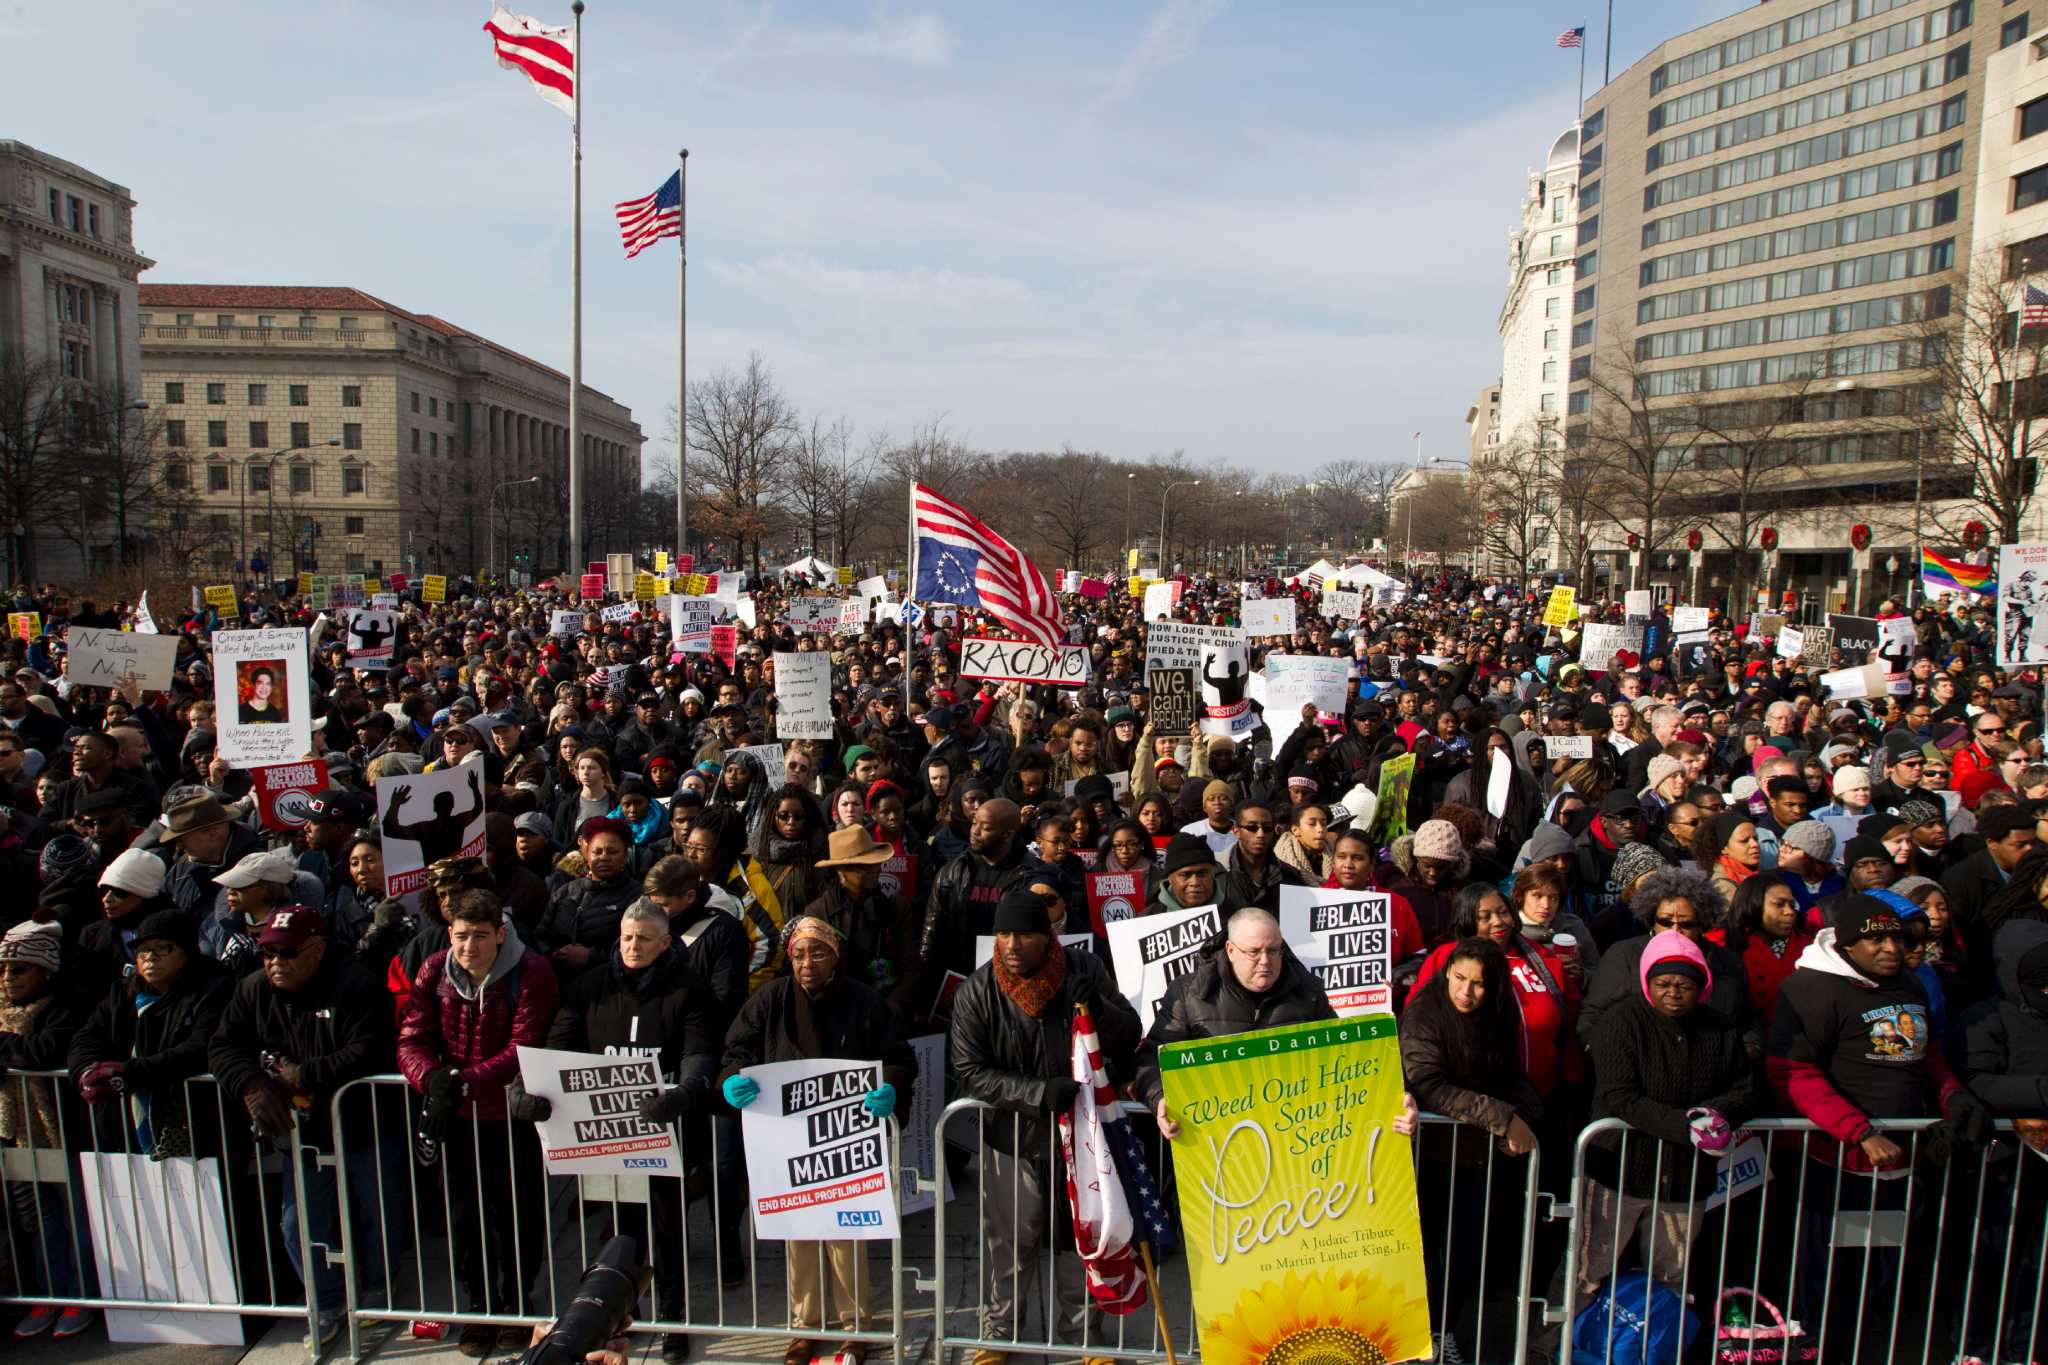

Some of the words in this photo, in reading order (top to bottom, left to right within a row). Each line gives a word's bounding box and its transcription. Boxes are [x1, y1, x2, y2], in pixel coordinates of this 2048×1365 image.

[845, 604, 861, 613] LIFE
[816, 616, 838, 625] AND
[843, 613, 861, 621] NOT
[683, 623, 709, 633] MATTER
[806, 624, 837, 632] FORGET
[1149, 624, 1171, 633] HOW
[1176, 626, 1204, 636] LONG
[1210, 629, 1236, 638] WILL
[1805, 627, 1827, 642] we
[1148, 635, 1195, 645] JUSTICE
[1600, 638, 1643, 649] INJUSTICE
[1841, 638, 1874, 649] BLACK
[1148, 646, 1175, 655] IFIED
[1151, 670, 1185, 694] we
[1152, 690, 1192, 711] can't
[805, 719, 831, 733] HUMAN
[1152, 709, 1193, 730] BREATHE
[1233, 713, 1254, 730] ACLU
[1558, 736, 1582, 746] Can't
[1551, 748, 1585, 758] Breathe
[264, 764, 314, 776] NATIONAL
[267, 769, 316, 782] ACTION
[265, 778, 318, 790] NETWORK
[1094, 874, 1134, 882] NATIONAL
[1096, 880, 1134, 890] ACTION
[1096, 888, 1136, 897] NETWORK
[272, 912, 293, 928] H
[1106, 908, 1131, 920] NAN
[1316, 901, 1383, 930] #BLACK
[1860, 918, 1901, 933] Jesus
[1145, 914, 1214, 961] #BLACK
[1334, 931, 1383, 957] LIVES
[1168, 953, 1201, 981] LIV
[1315, 960, 1385, 990] MATTER
[1328, 993, 1367, 1007] PROFILING
[1367, 991, 1386, 1003] NOW
[630, 1016, 639, 1042] I
[1180, 1046, 1245, 1066] Marc
[1269, 1025, 1379, 1053] Daniels
[568, 1064, 652, 1091] #BLACK
[789, 1069, 873, 1112] #BLACK
[1183, 1084, 1256, 1126] Weed
[1262, 1075, 1310, 1104] Out
[1318, 1053, 1380, 1090] Hate;
[1274, 1100, 1327, 1132] Sow
[1335, 1083, 1369, 1109] the
[579, 1115, 663, 1141] MATTER
[814, 1103, 874, 1143] LIVES
[1289, 1114, 1353, 1156] Seeds
[549, 1149, 568, 1160] END
[568, 1146, 600, 1159] RACIAL
[601, 1142, 647, 1155] PROFILING
[648, 1138, 670, 1149] NOW
[626, 1158, 666, 1168] ACLU
[793, 1138, 878, 1185] MATTER
[1311, 1144, 1337, 1180] of
[759, 1198, 779, 1212] END
[780, 1193, 815, 1209] RACIAL
[815, 1183, 861, 1203] PROFILING
[863, 1176, 885, 1191] NOW
[1200, 1118, 1382, 1266] Peace!
[840, 1211, 881, 1226] ACLU
[1299, 1240, 1309, 1251] A
[1313, 1232, 1350, 1248] Judaic
[1353, 1227, 1396, 1243] Tribute
[1260, 1262, 1273, 1273] to
[1276, 1254, 1317, 1271] Martin
[1320, 1247, 1359, 1265] Luther
[1361, 1243, 1394, 1258] King,
[1396, 1239, 1411, 1254] Jr.
